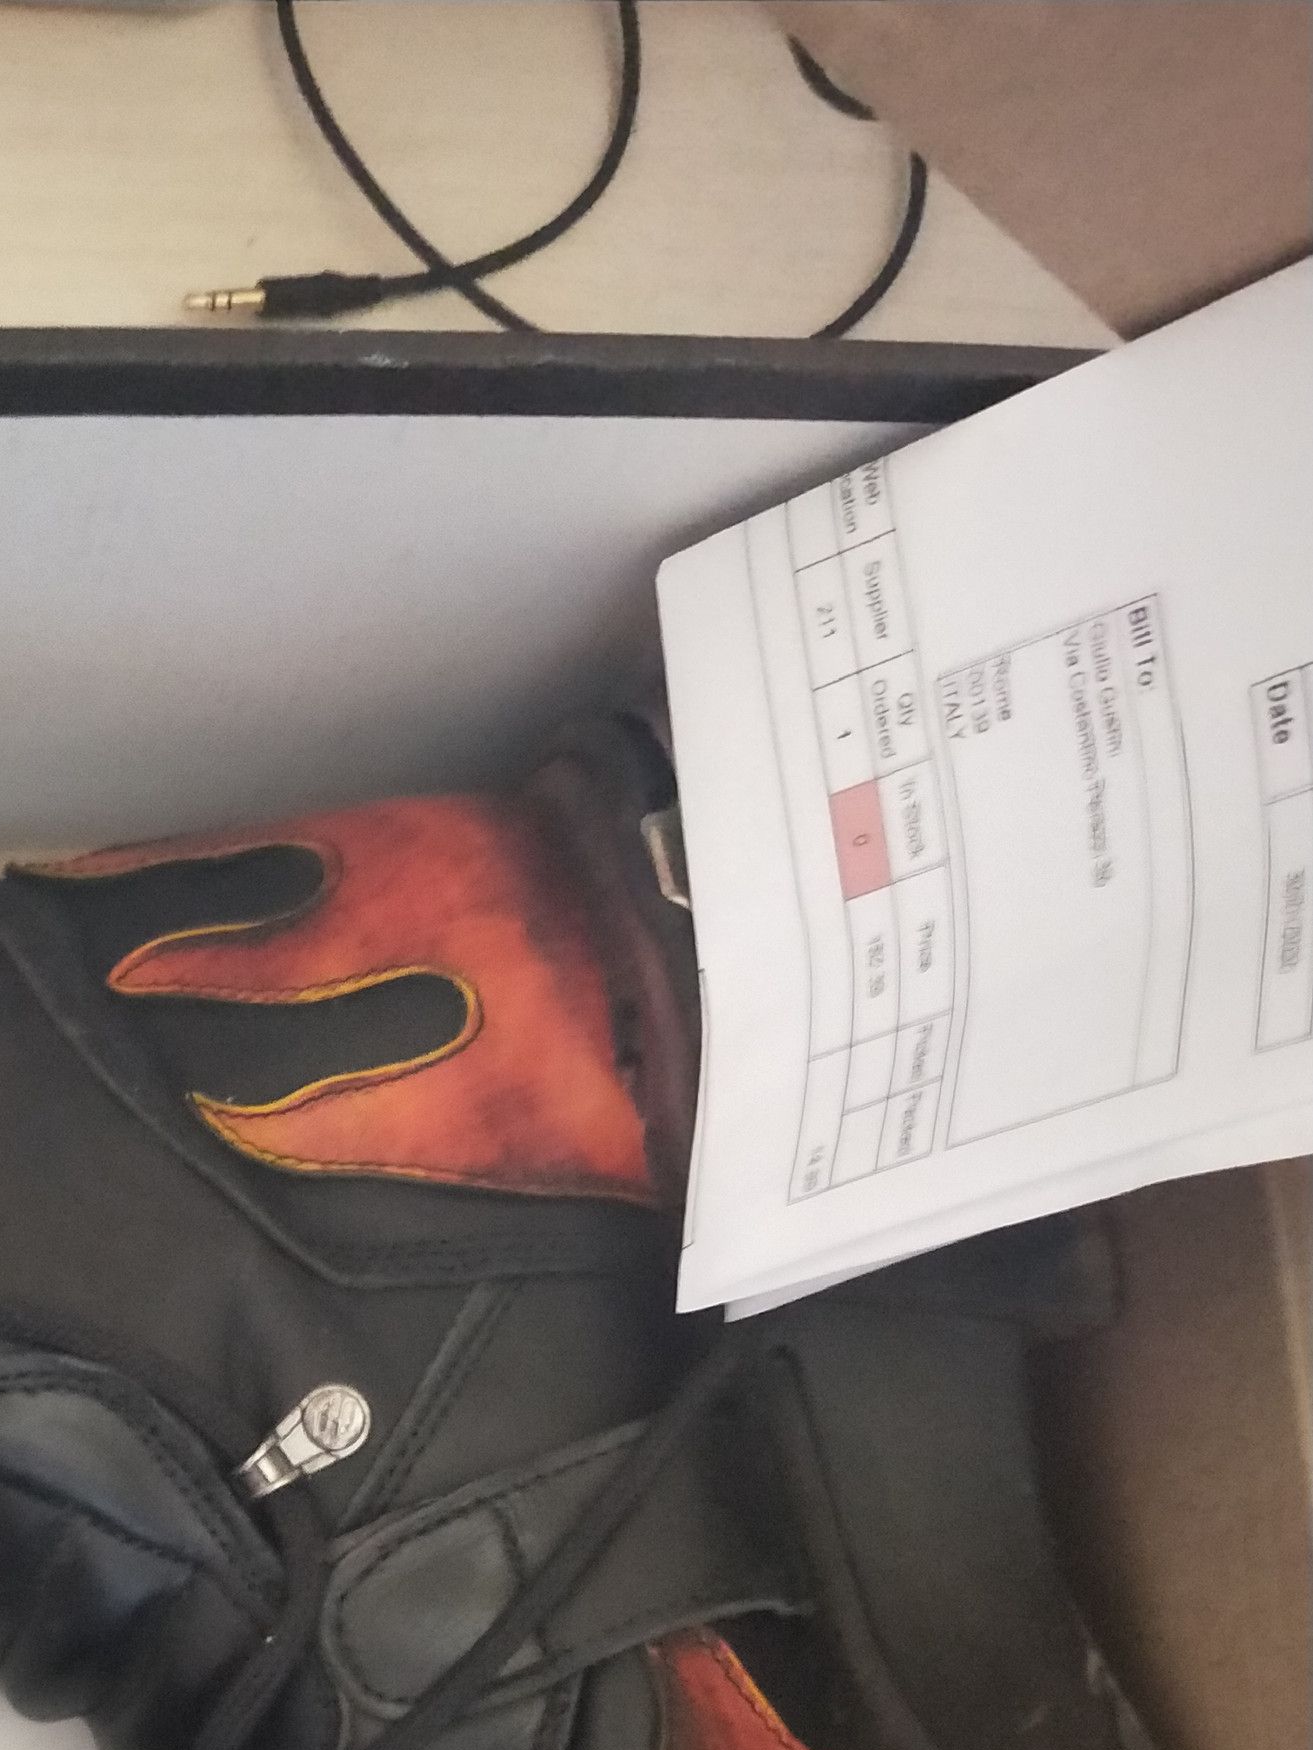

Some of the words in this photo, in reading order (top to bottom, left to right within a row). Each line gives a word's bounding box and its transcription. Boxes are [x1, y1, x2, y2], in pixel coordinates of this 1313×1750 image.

[861, 459, 881, 506] Web
[863, 560, 889, 640] Supplier
[1063, 630, 1081, 668] Via
[1127, 605, 1154, 648] Bill
[897, 692, 915, 727] Qty
[942, 680, 967, 739] ITALY
[991, 654, 1012, 722] Rome
[871, 679, 897, 760] Ordered
[1266, 680, 1293, 745] Date
[898, 778, 918, 802] In
[851, 833, 872, 848] 0
